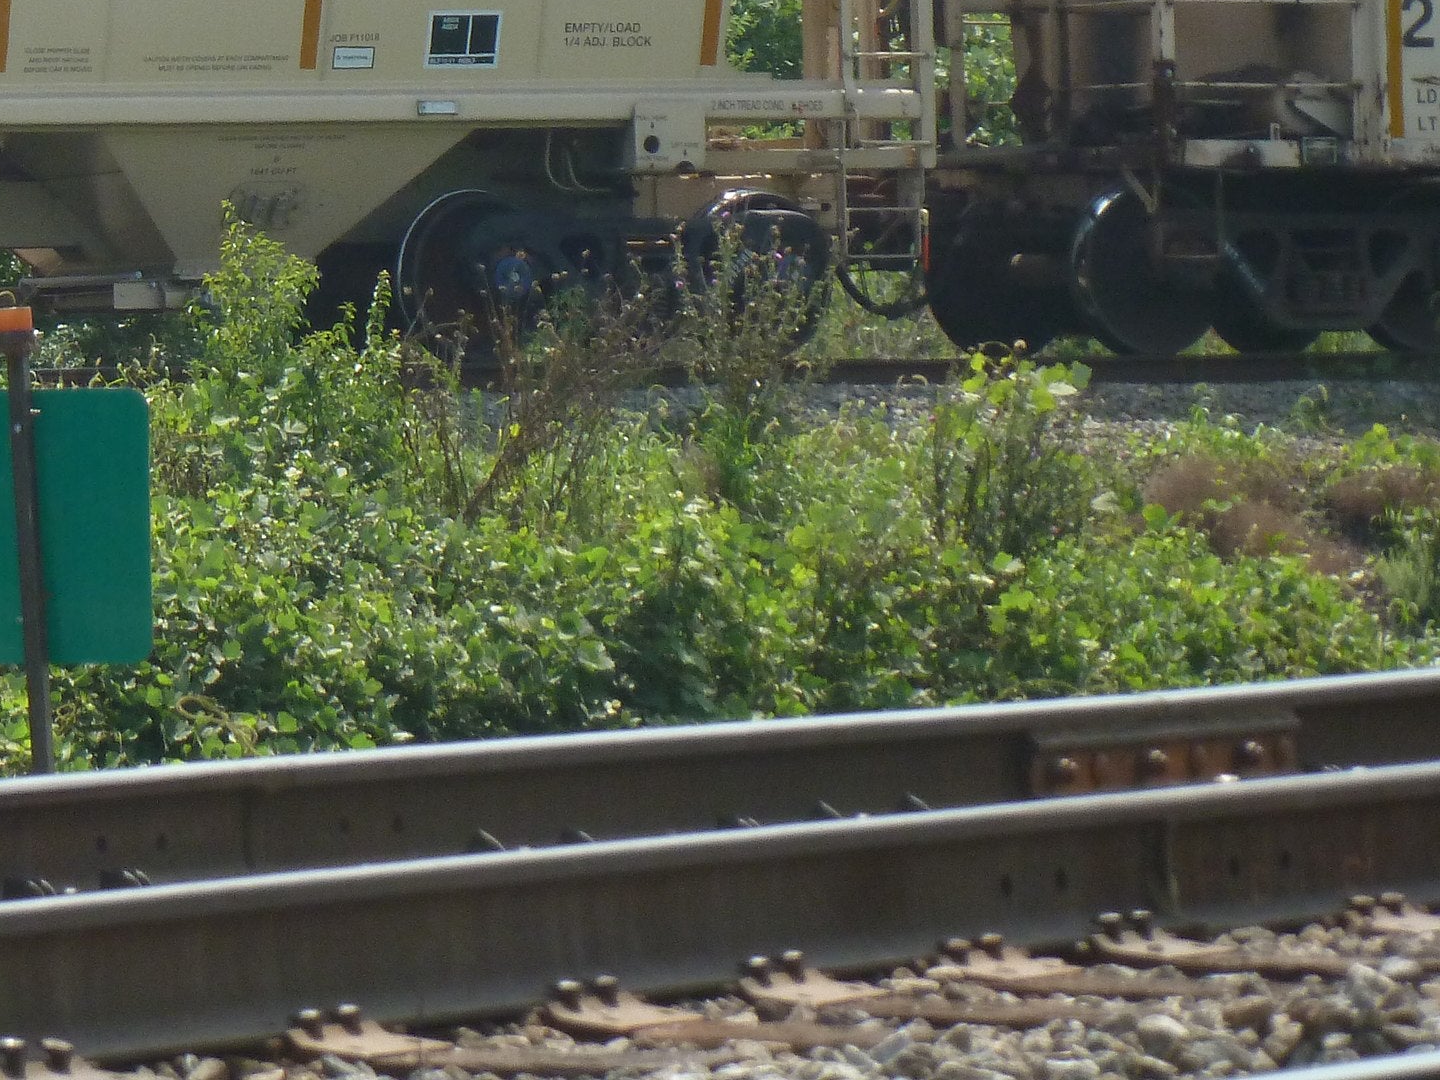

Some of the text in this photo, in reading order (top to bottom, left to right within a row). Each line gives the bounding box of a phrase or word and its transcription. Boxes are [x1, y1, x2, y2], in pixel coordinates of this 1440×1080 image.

[564, 22, 641, 33] EMPTY/LOAD
[563, 36, 580, 47] 1/4
[612, 35, 653, 47] BLOCK
